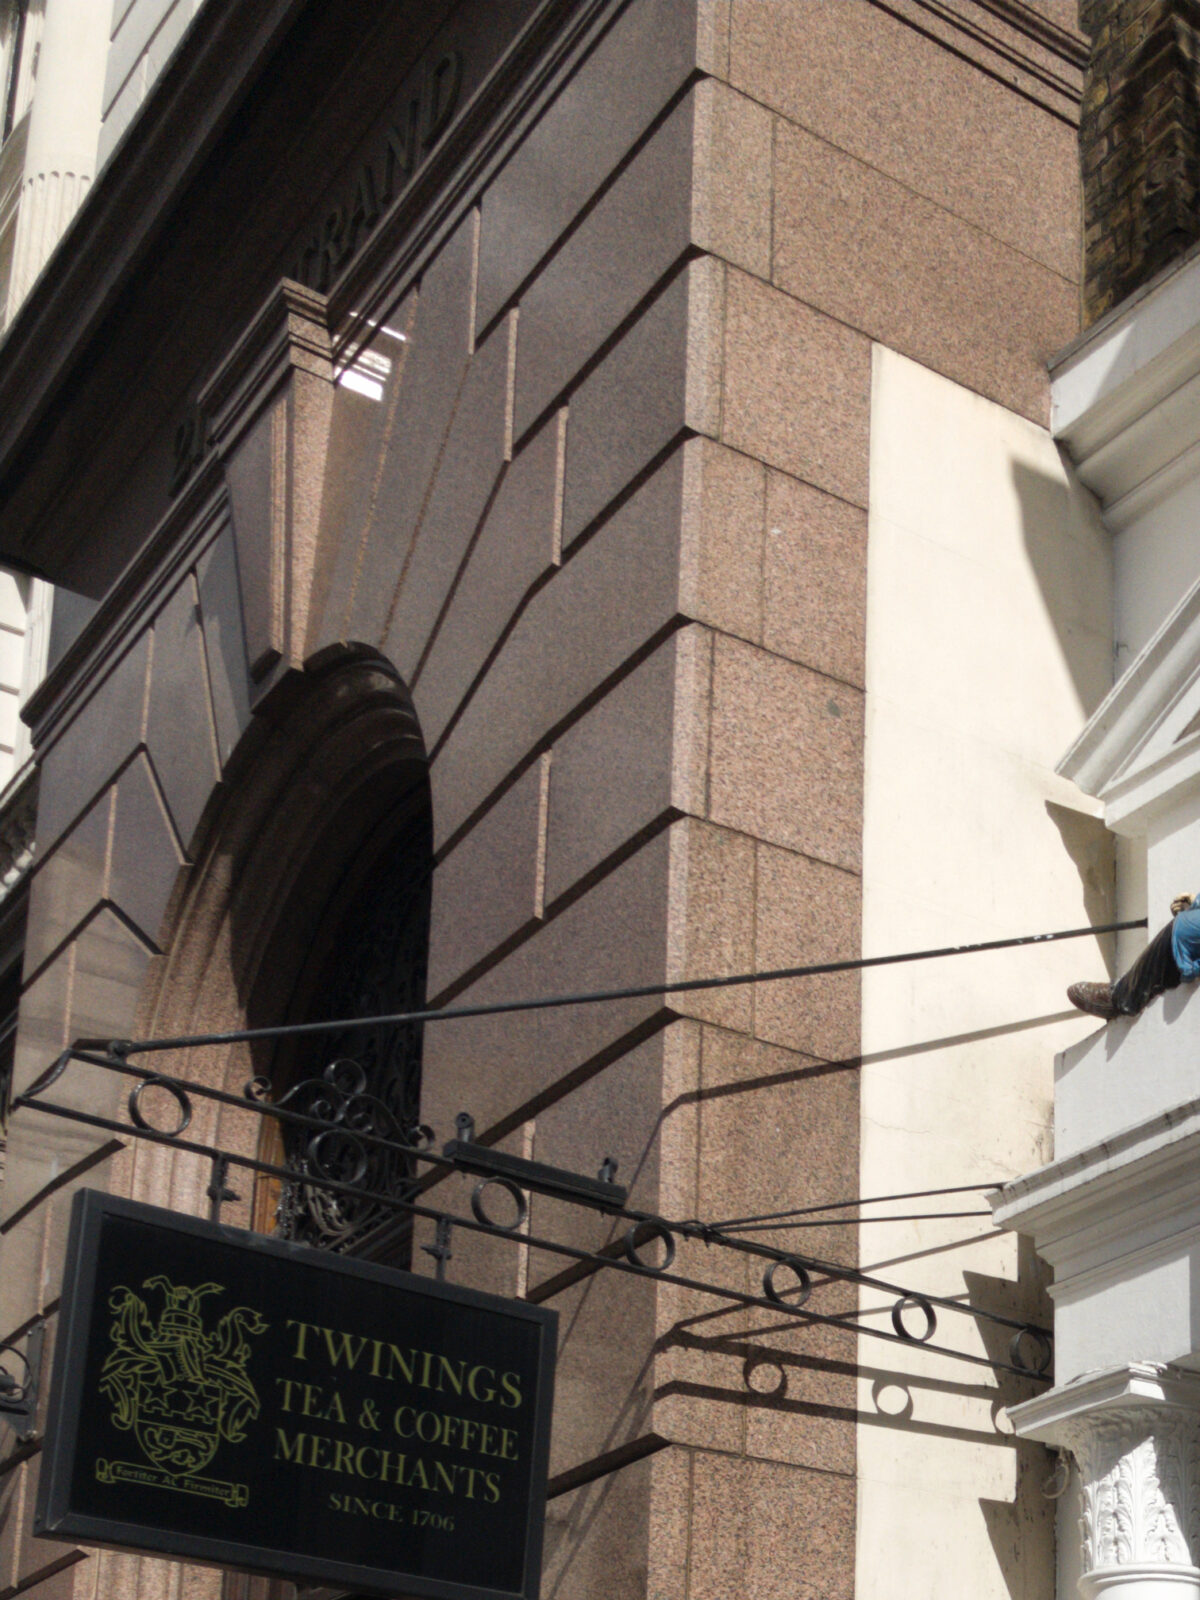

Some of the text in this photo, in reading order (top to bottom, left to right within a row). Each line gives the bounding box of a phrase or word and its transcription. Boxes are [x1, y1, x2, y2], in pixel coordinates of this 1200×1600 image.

[286, 1319, 523, 1409] TWININGS
[275, 1377, 519, 1460] TEA & COFFEE
[274, 1427, 501, 1505] MERCHANTS
[328, 1492, 456, 1532] SINCE 1706
